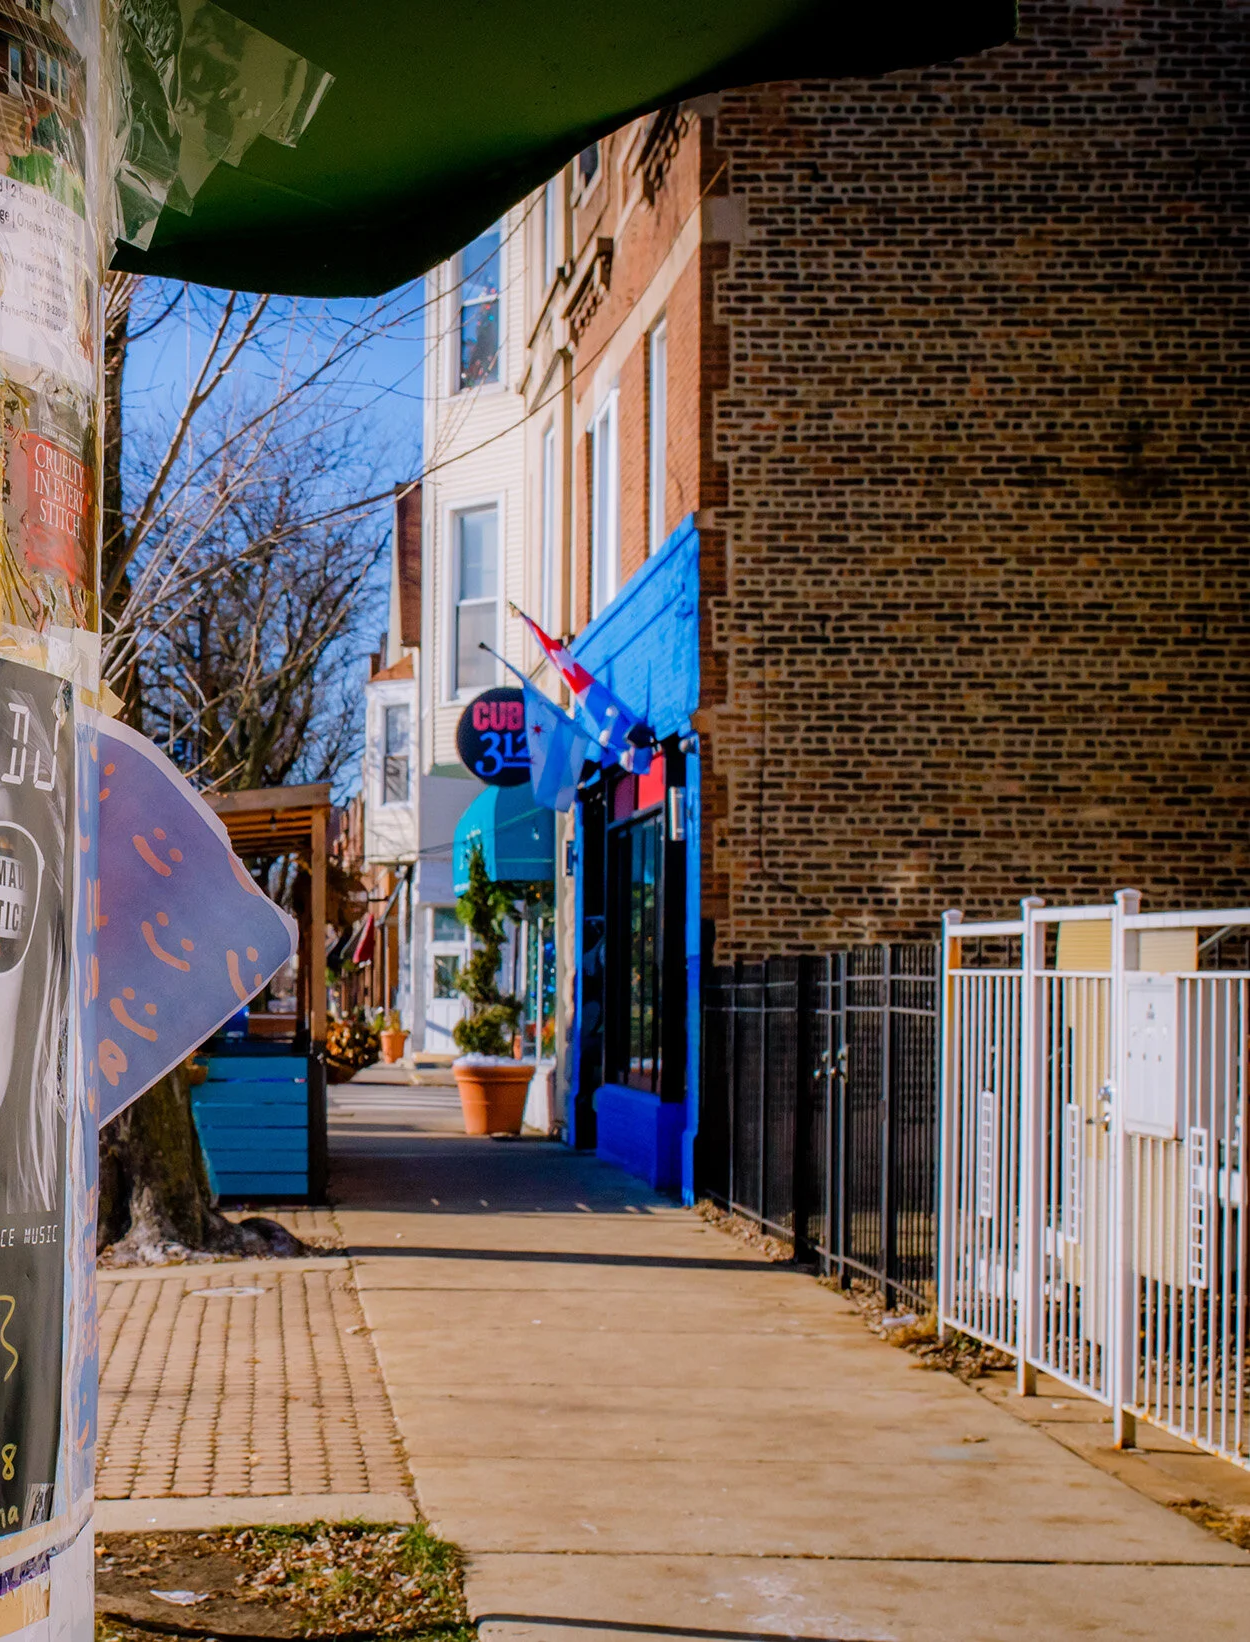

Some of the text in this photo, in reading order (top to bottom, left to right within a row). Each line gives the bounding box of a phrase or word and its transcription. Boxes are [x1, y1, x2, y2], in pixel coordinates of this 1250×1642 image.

[34, 443, 84, 488] CRUELTY
[34, 468, 84, 515] IN EVERY
[39, 499, 80, 539] STITCH
[473, 701, 524, 731] CUB
[475, 732, 530, 776] 312
[23, 1225, 58, 1245] MUSIC
